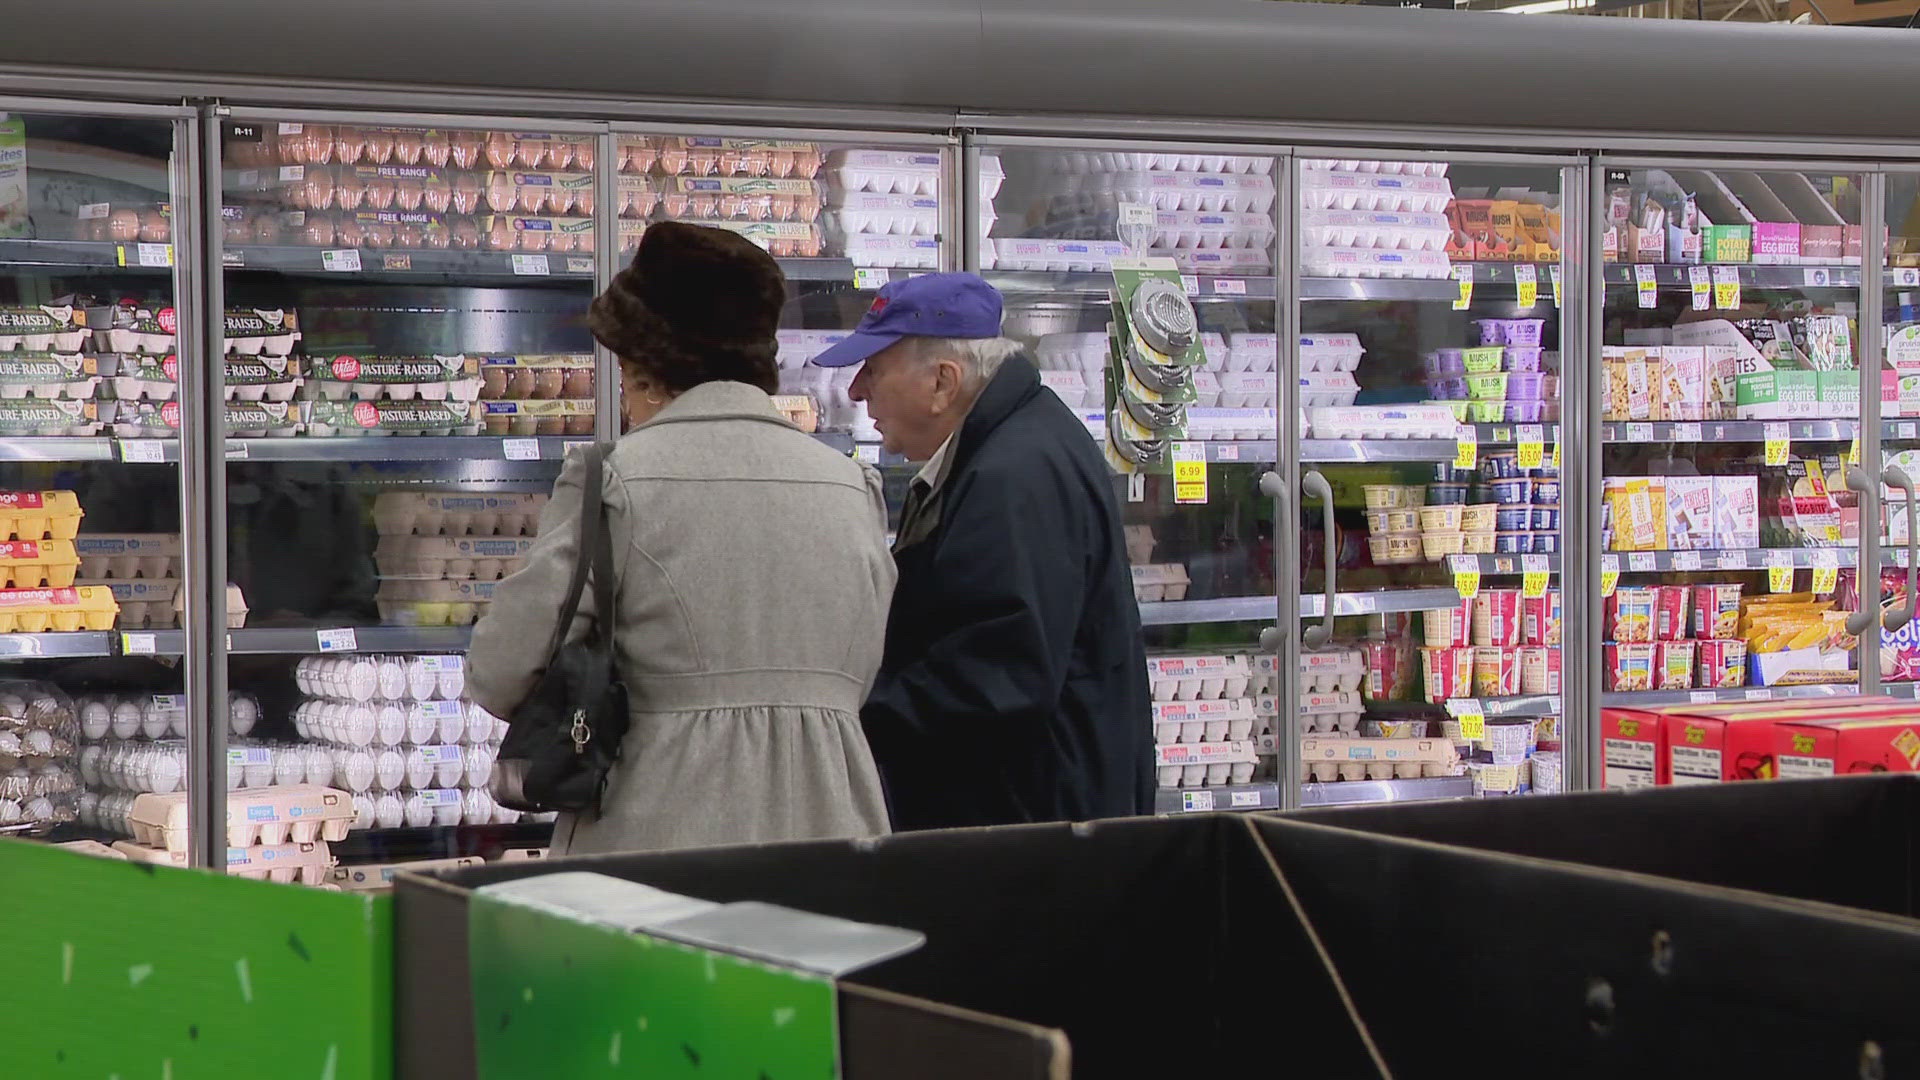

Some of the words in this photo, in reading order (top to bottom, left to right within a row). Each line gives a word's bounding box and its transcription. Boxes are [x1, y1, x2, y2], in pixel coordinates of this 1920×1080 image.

[234, 127, 253, 136] R-11
[378, 168, 397, 176] FREE
[400, 168, 427, 177] RANGE
[1611, 172, 1625, 180] R-09
[378, 213, 398, 222] FREE
[400, 214, 428, 223] RANGE
[1716, 238, 1749, 249] POTATO
[1761, 242, 1777, 253] EGG
[1778, 242, 1798, 254] BITES
[1716, 249, 1748, 261] BAKES
[1469, 353, 1489, 362] MUSH
[333, 360, 357, 374] Vital
[360, 364, 440, 375] PASTURE-RAISED
[1480, 378, 1500, 387] MUSH
[1779, 391, 1794, 401] EGG
[1794, 391, 1816, 401] BITES
[1822, 391, 1838, 401] EGG
[1838, 391, 1860, 401] BITES
[353, 405, 376, 419] Vital
[379, 410, 451, 421] PASTURE-RAISED
[1519, 450, 1542, 461] 3/5.00
[1767, 448, 1788, 459] 3.99
[1180, 466, 1200, 476] 6.99
[1524, 580, 1546, 591] 2/4.00
[1462, 724, 1483, 734] 2/7.00
[1606, 740, 1632, 749] Nutrition
[1635, 743, 1652, 751] Facts
[1780, 758, 1809, 767] Nutrition
[1812, 759, 1832, 768] Facts
